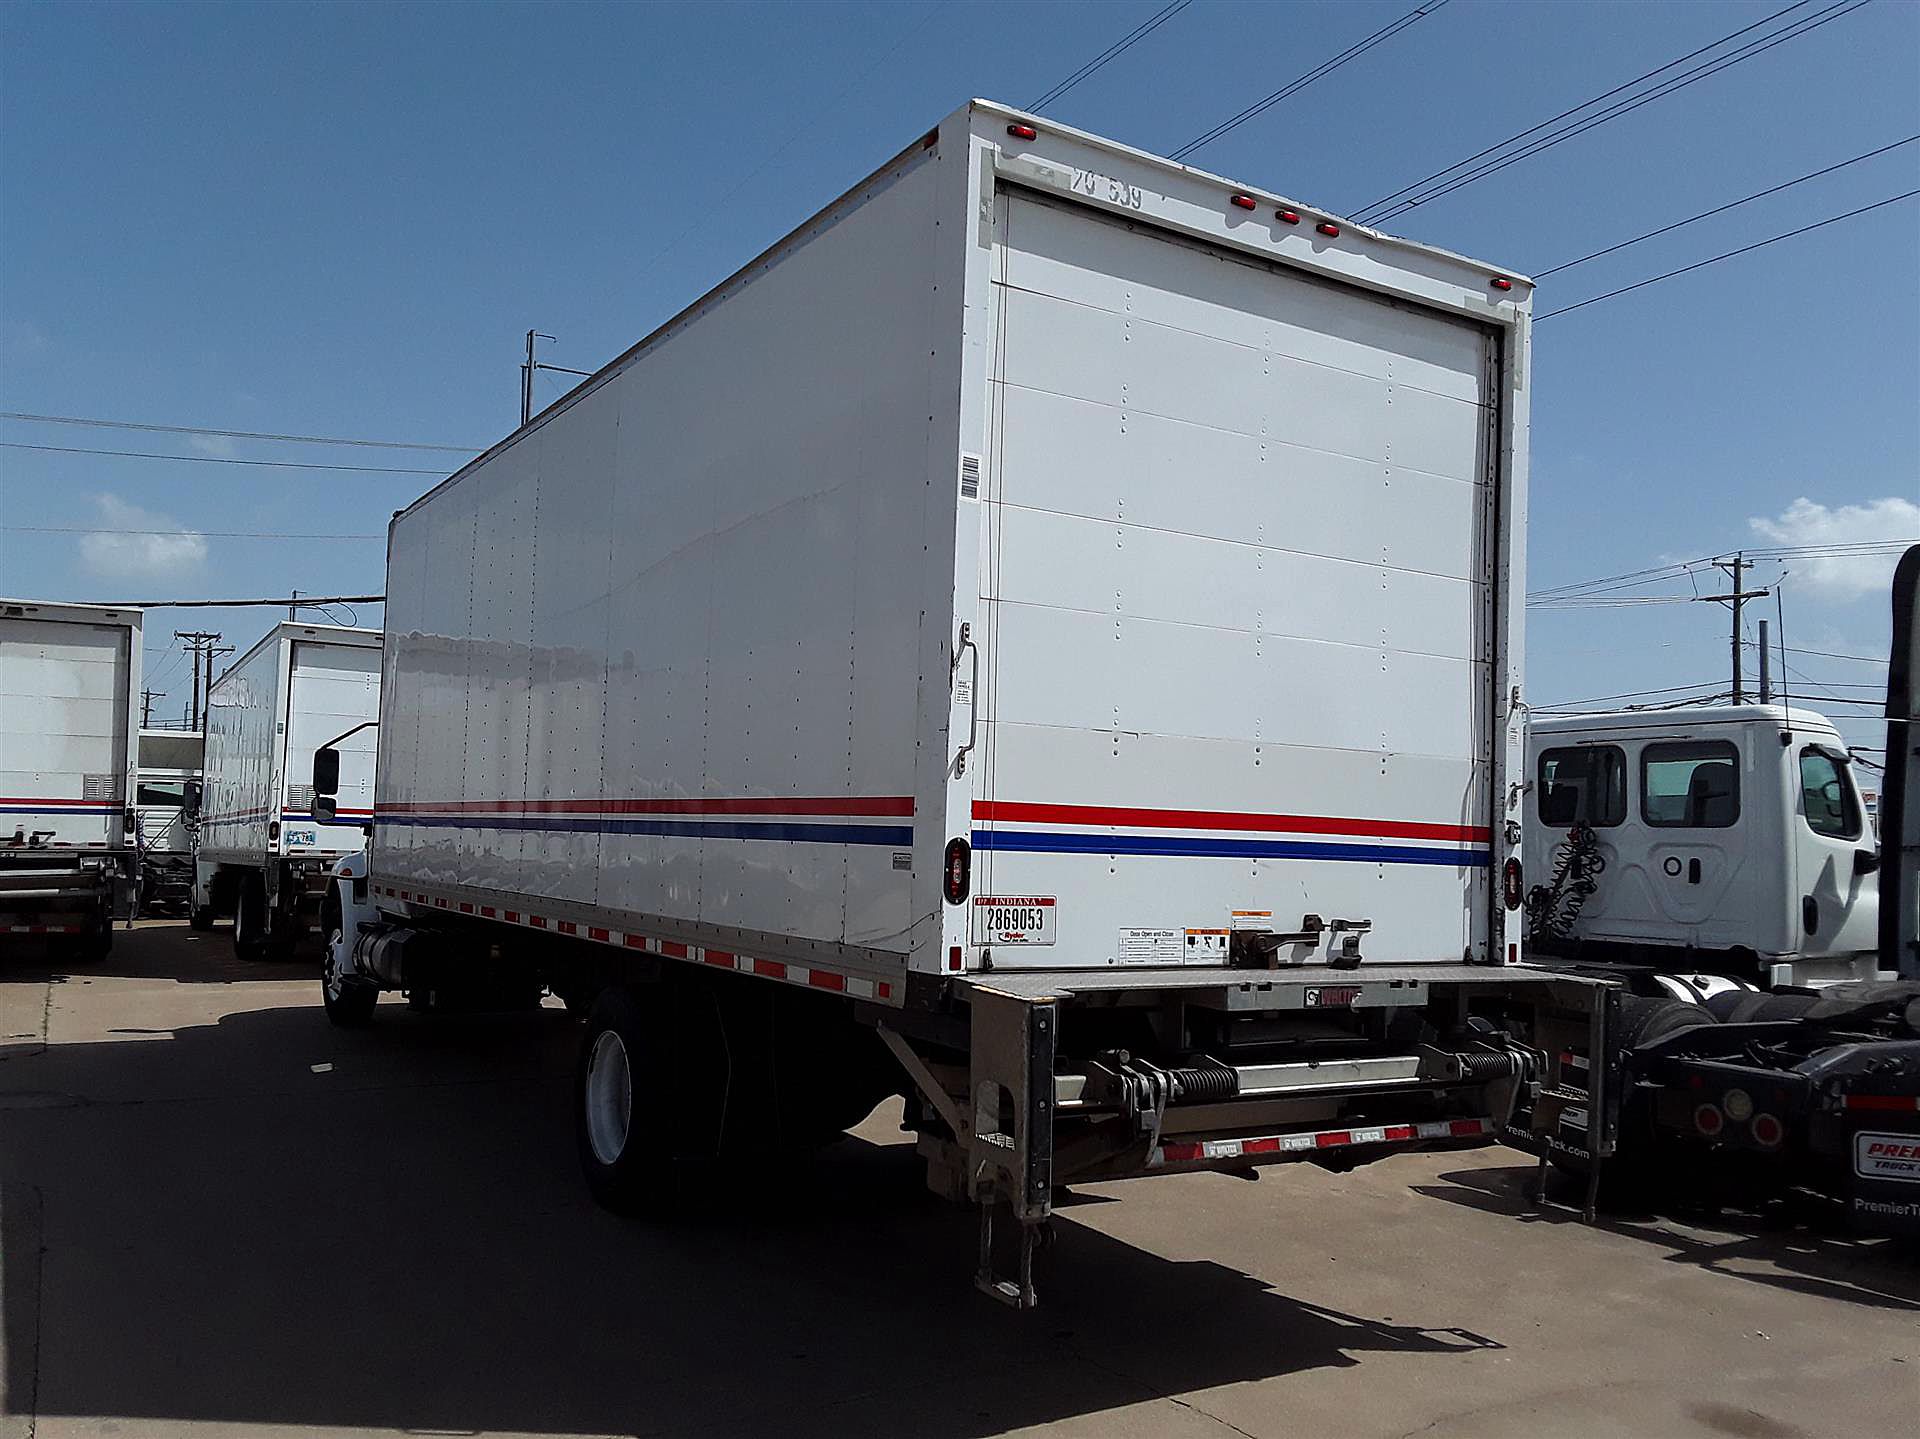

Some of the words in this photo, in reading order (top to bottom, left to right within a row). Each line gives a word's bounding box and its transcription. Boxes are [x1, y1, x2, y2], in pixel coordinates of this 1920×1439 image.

[995, 897, 1037, 906] INDIANA
[987, 908, 1043, 930] 2869053
[1854, 1198, 1920, 1216] PremierT
